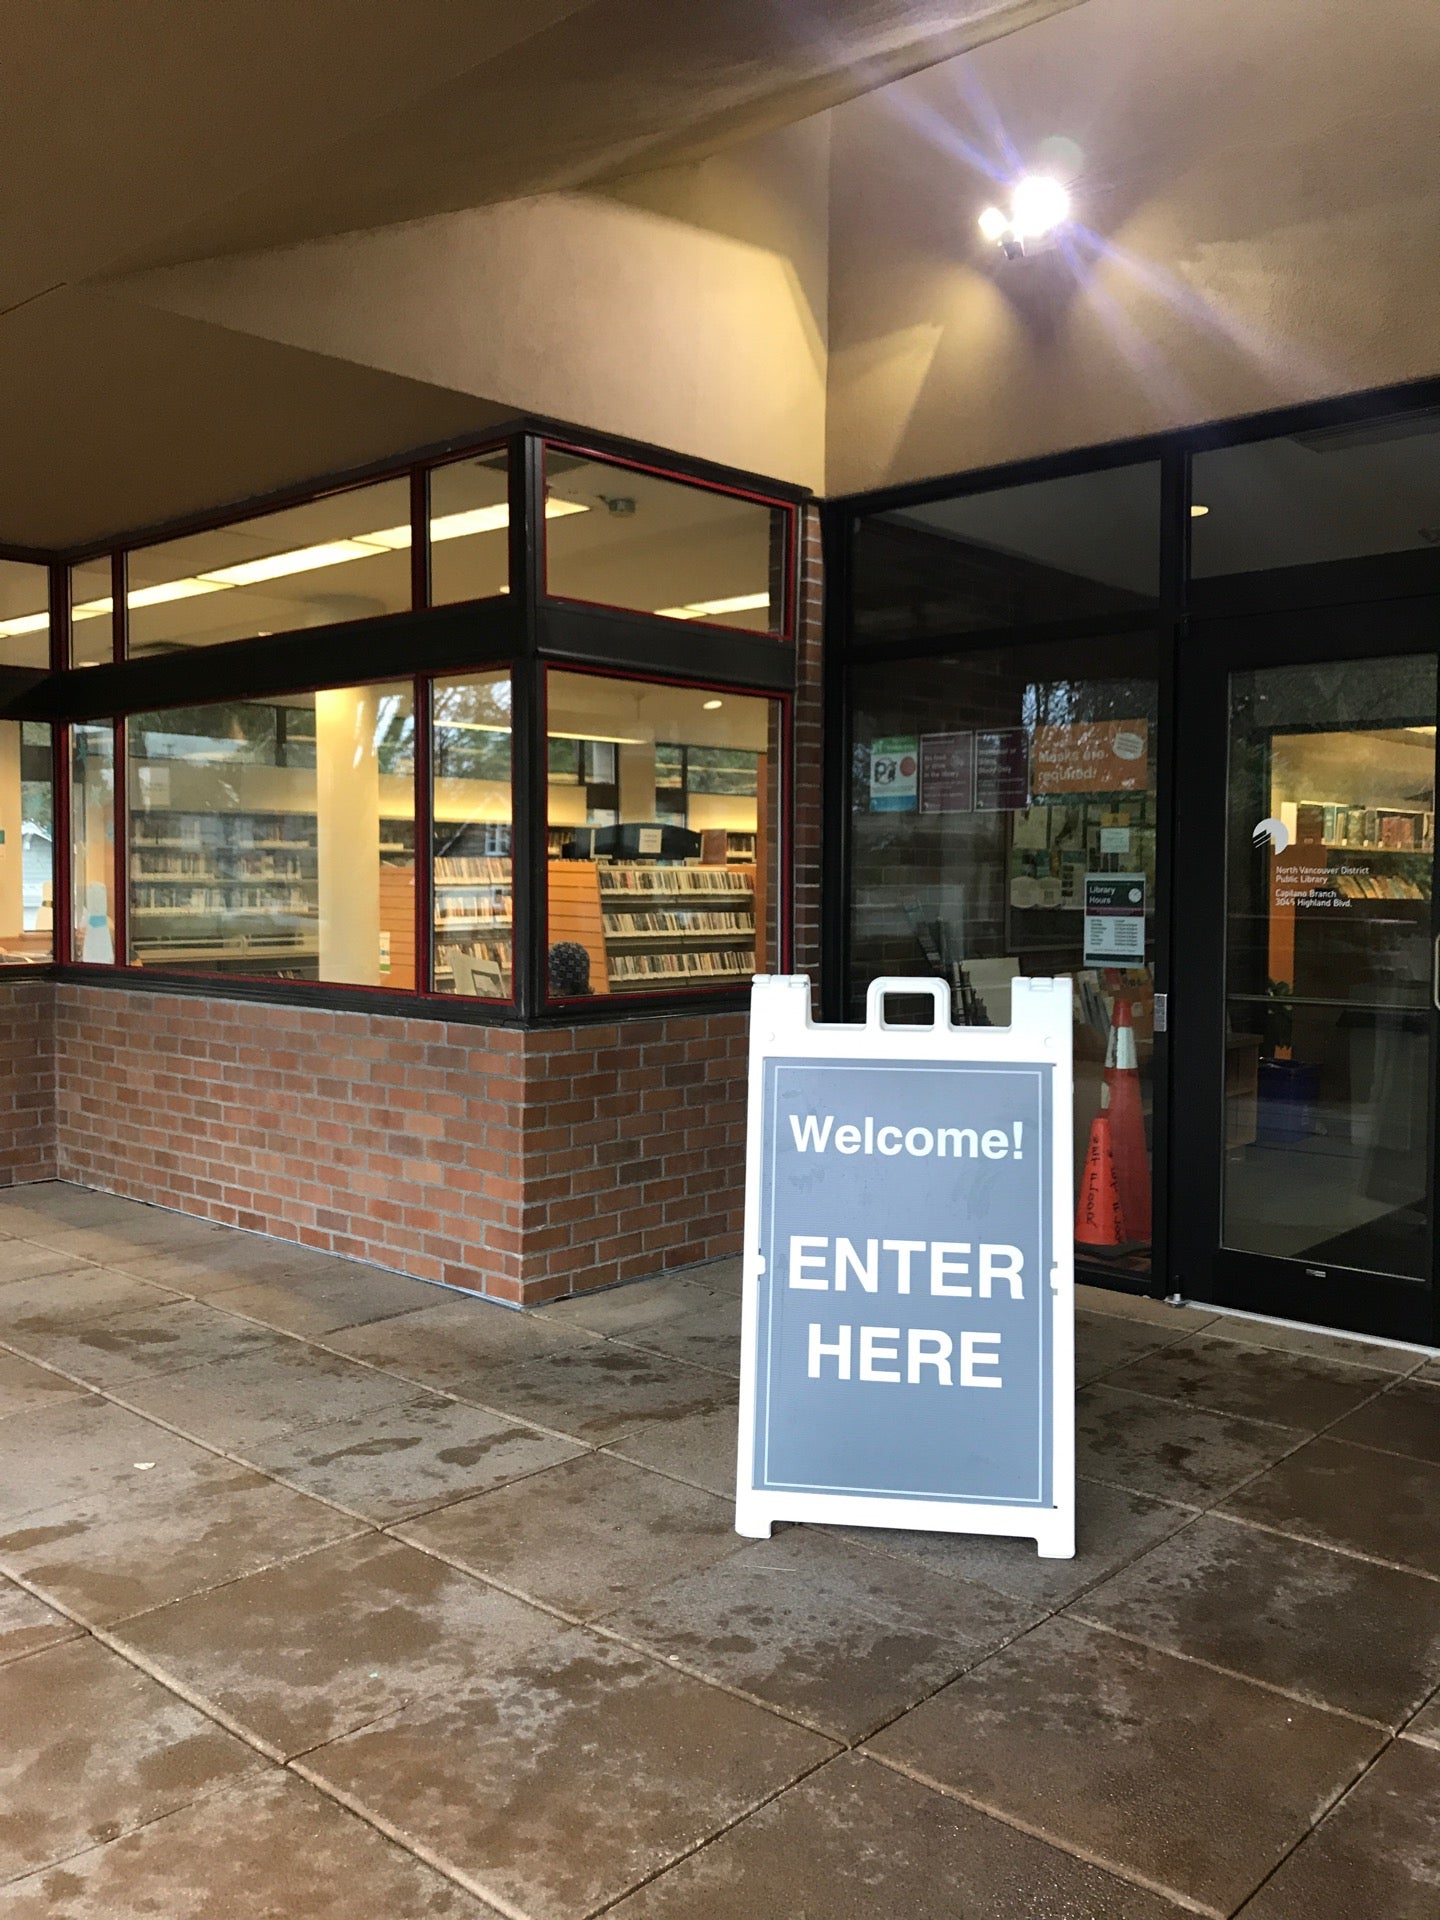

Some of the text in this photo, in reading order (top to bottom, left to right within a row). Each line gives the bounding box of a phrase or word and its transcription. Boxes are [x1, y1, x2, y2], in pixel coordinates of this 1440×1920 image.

[1275, 866, 1370, 875] North Vancouver District
[1275, 875, 1328, 885] Public Library
[1089, 886, 1116, 896] Library
[1275, 889, 1337, 898] Capilano Branch
[1089, 896, 1112, 905] Hours
[1297, 899, 1331, 909] Highland
[1333, 899, 1353, 908] Blvd.
[788, 1114, 1024, 1160] Welcome!
[1086, 1172, 1099, 1229] FLOOR
[788, 1235, 1025, 1300] ENTER
[807, 1323, 1003, 1389] HERE
